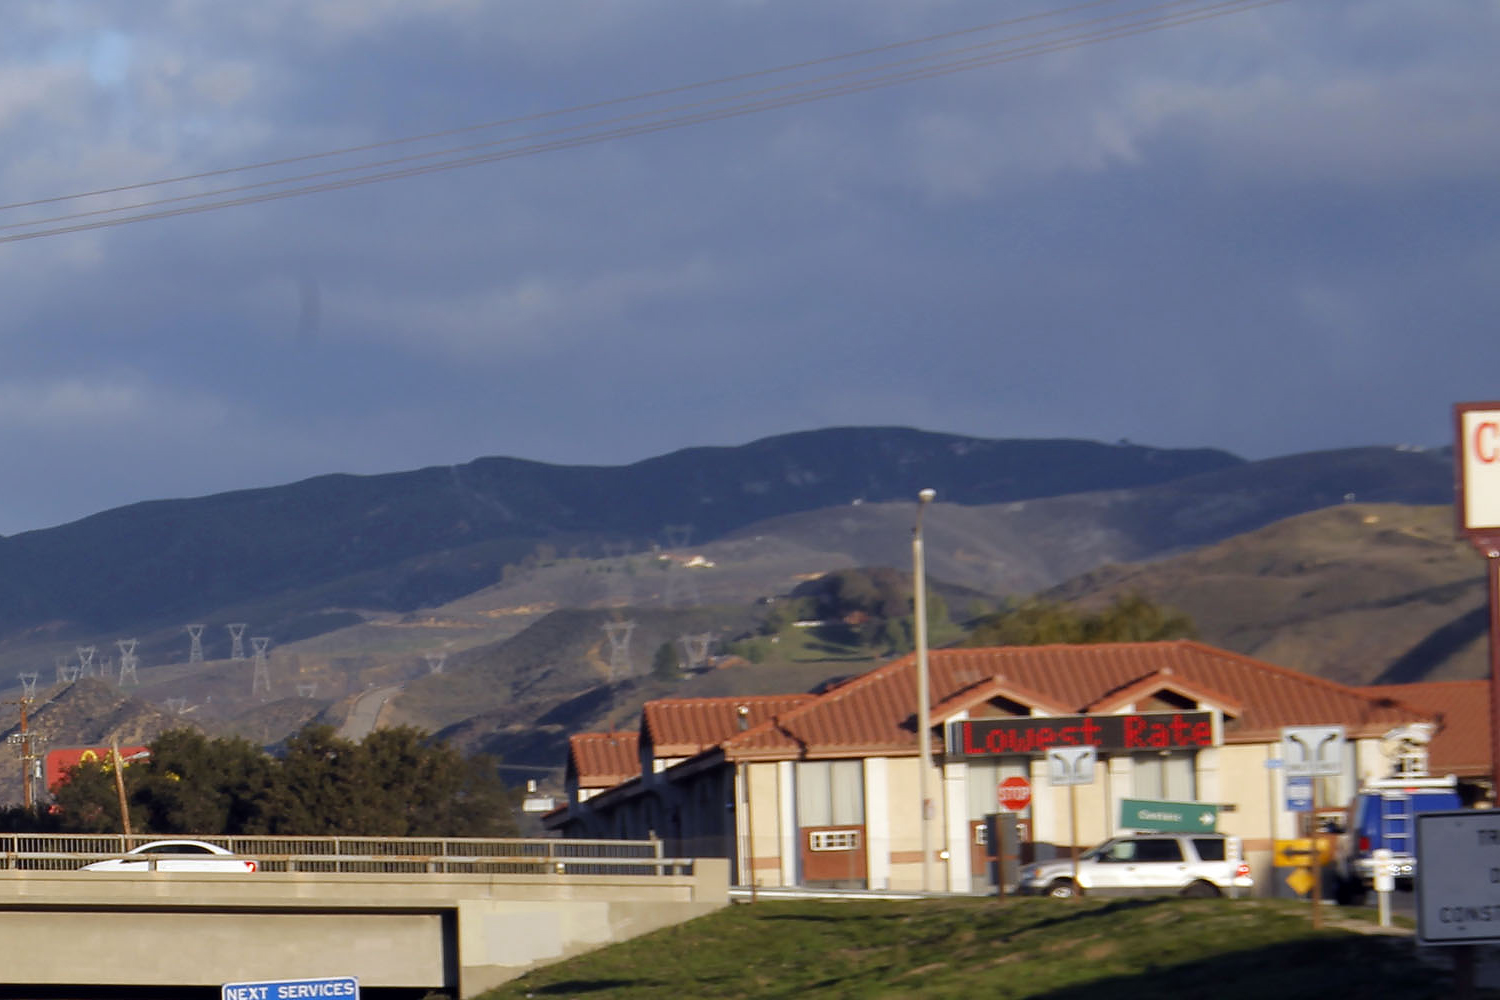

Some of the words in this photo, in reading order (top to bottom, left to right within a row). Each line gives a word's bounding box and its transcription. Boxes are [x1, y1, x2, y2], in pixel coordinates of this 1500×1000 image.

[963, 717, 1102, 754] Lowest
[1123, 714, 1213, 749] Rate
[998, 786, 1030, 800] STOP
[278, 982, 354, 1000] SERVICES
